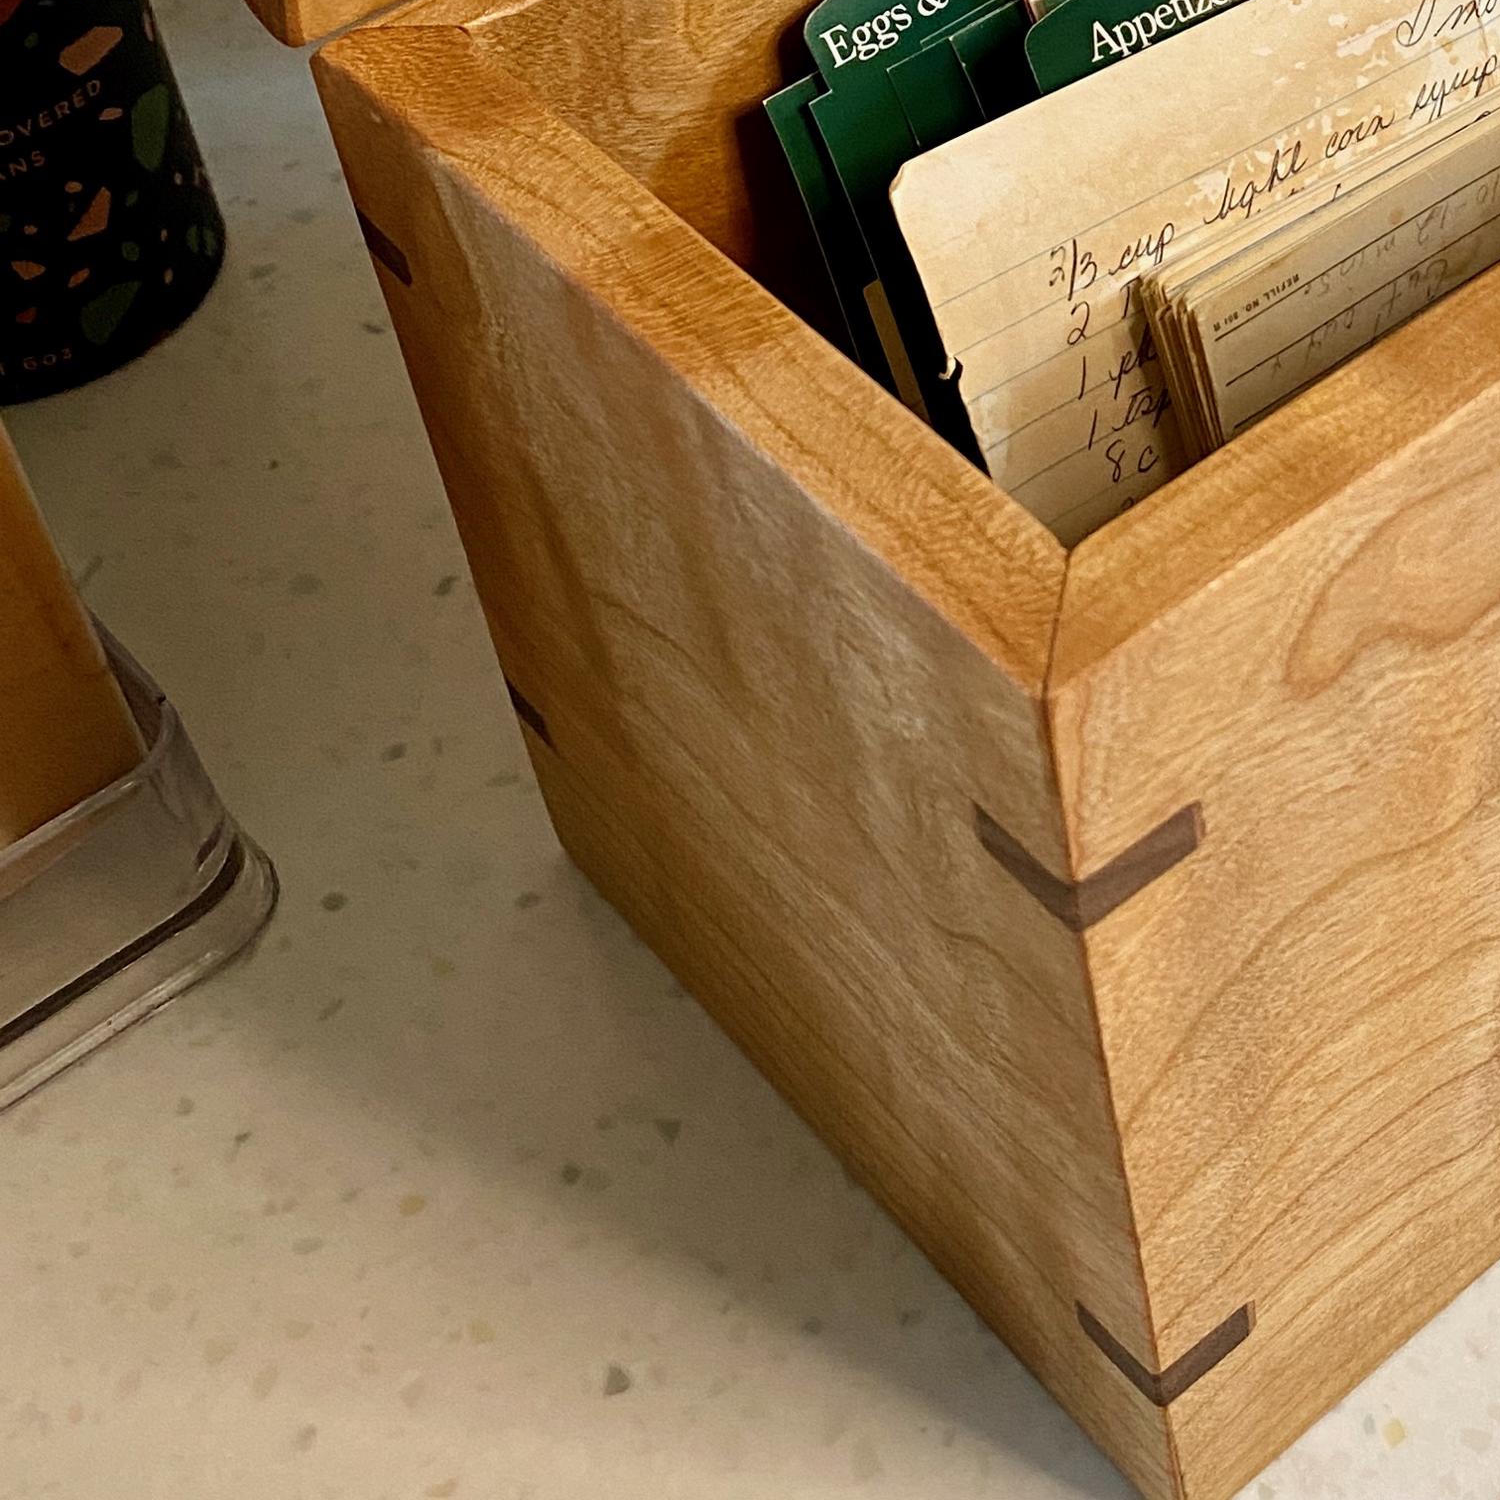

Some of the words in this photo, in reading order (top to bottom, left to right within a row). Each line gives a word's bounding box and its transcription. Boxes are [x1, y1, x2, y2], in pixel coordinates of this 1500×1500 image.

[818, 3, 913, 69] Eggs
[1107, 222, 1175, 277] cup
[1203, 140, 1309, 225] light
[1324, 111, 1396, 159] corn
[1262, 272, 1300, 300] REFILL
[1066, 300, 1091, 346] 2
[1105, 438, 1127, 483] 8
